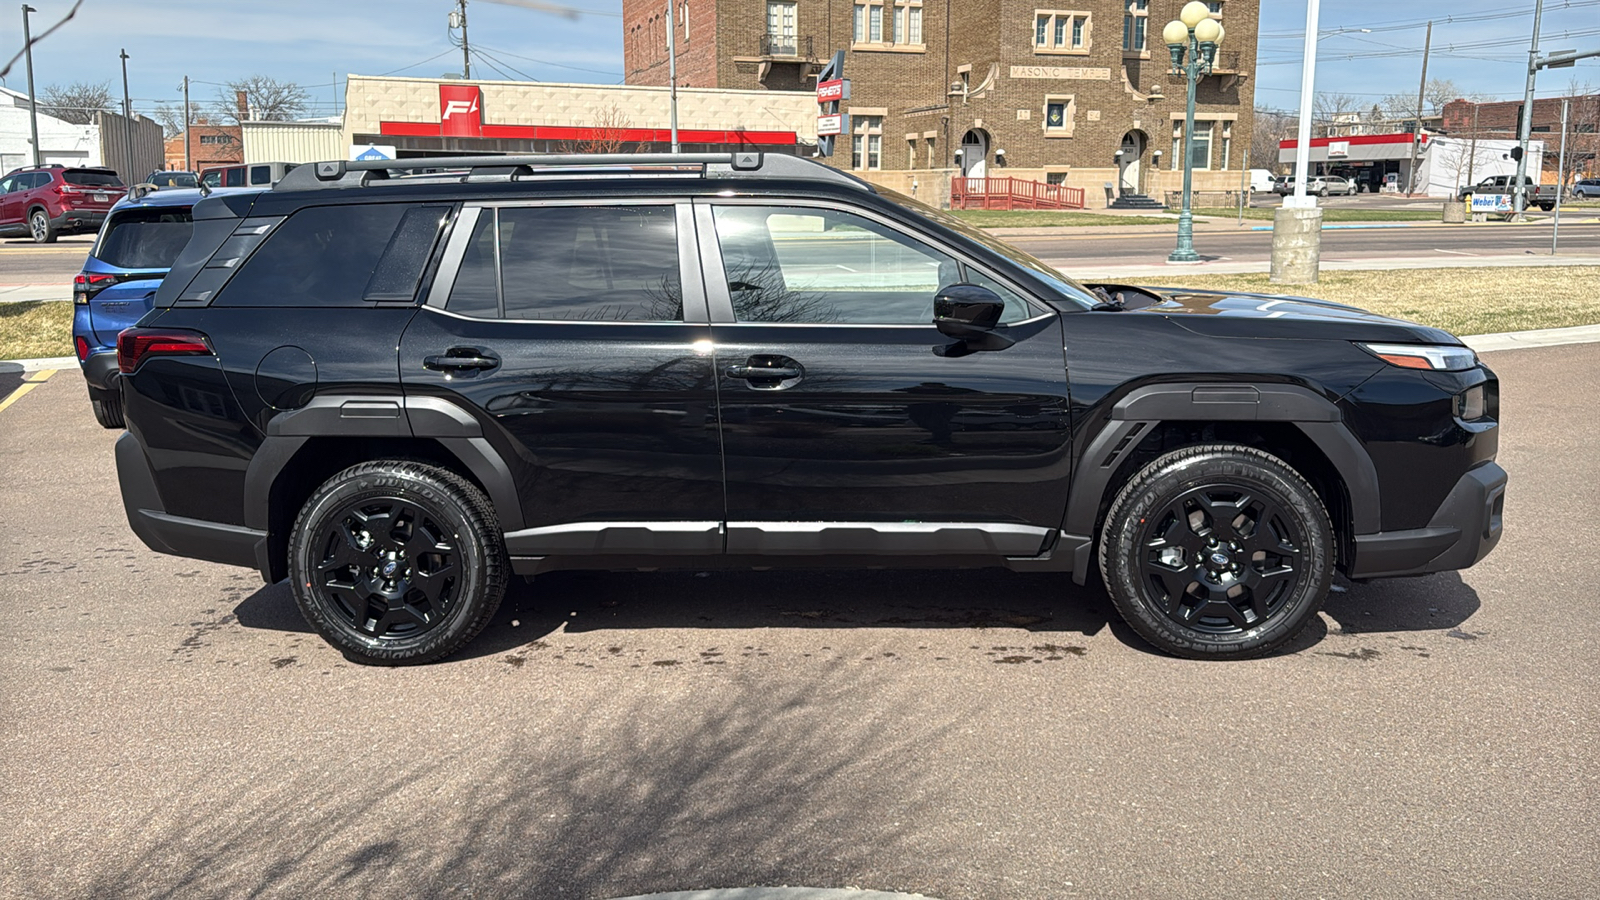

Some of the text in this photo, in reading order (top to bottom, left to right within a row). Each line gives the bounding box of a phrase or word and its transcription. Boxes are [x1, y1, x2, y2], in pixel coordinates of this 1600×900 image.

[1011, 67, 1109, 79] MASONIC TEMPLE
[1473, 196, 1495, 206] Weber
